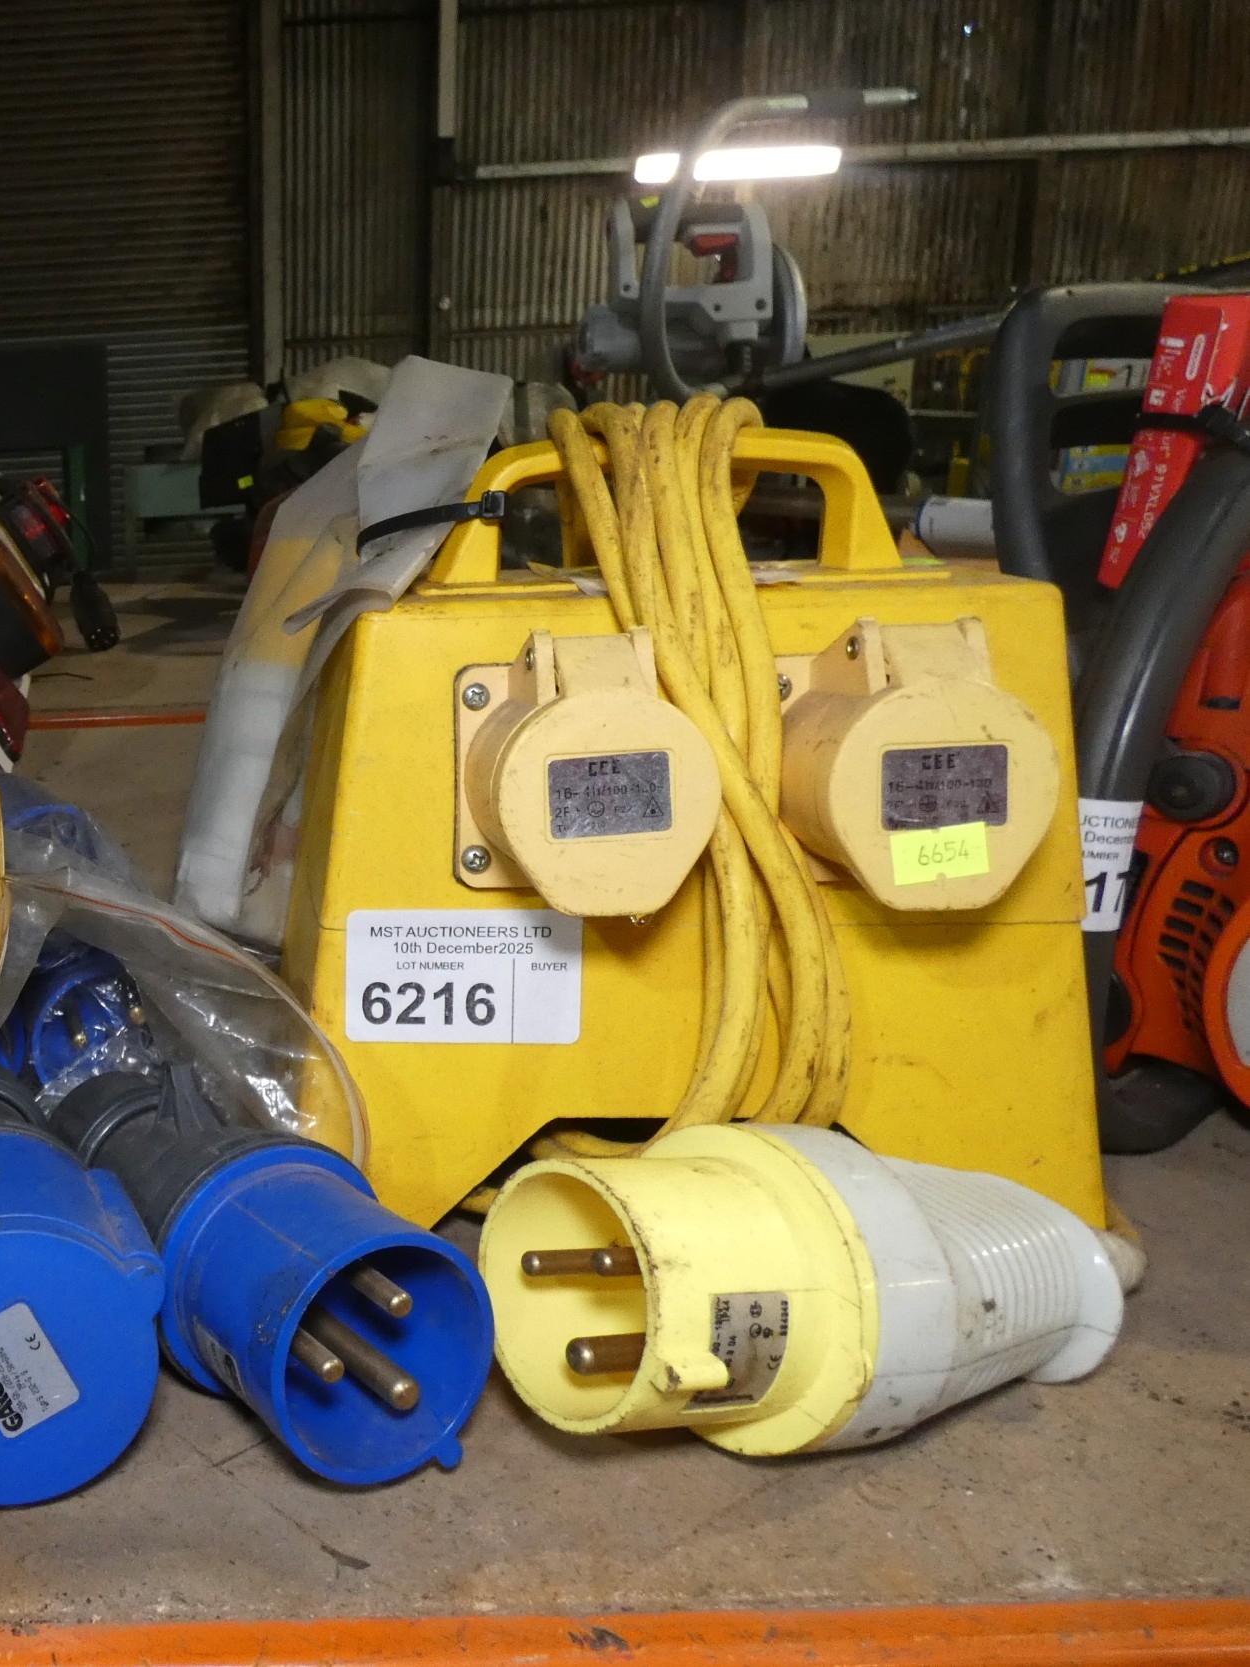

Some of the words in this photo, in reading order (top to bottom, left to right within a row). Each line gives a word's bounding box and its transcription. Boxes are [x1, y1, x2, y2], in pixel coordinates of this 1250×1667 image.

[588, 759, 621, 777] CEE
[917, 840, 970, 866] 6654
[1082, 851, 1119, 861] UMBER
[370, 926, 403, 938] MST
[406, 926, 519, 939] AUCTIONEERS
[523, 926, 552, 938] LTD
[393, 941, 422, 954] 10th
[396, 961, 418, 970] LOT
[420, 961, 465, 971] NUMBER
[531, 962, 568, 971] BUYER
[361, 981, 496, 1026] 6216
